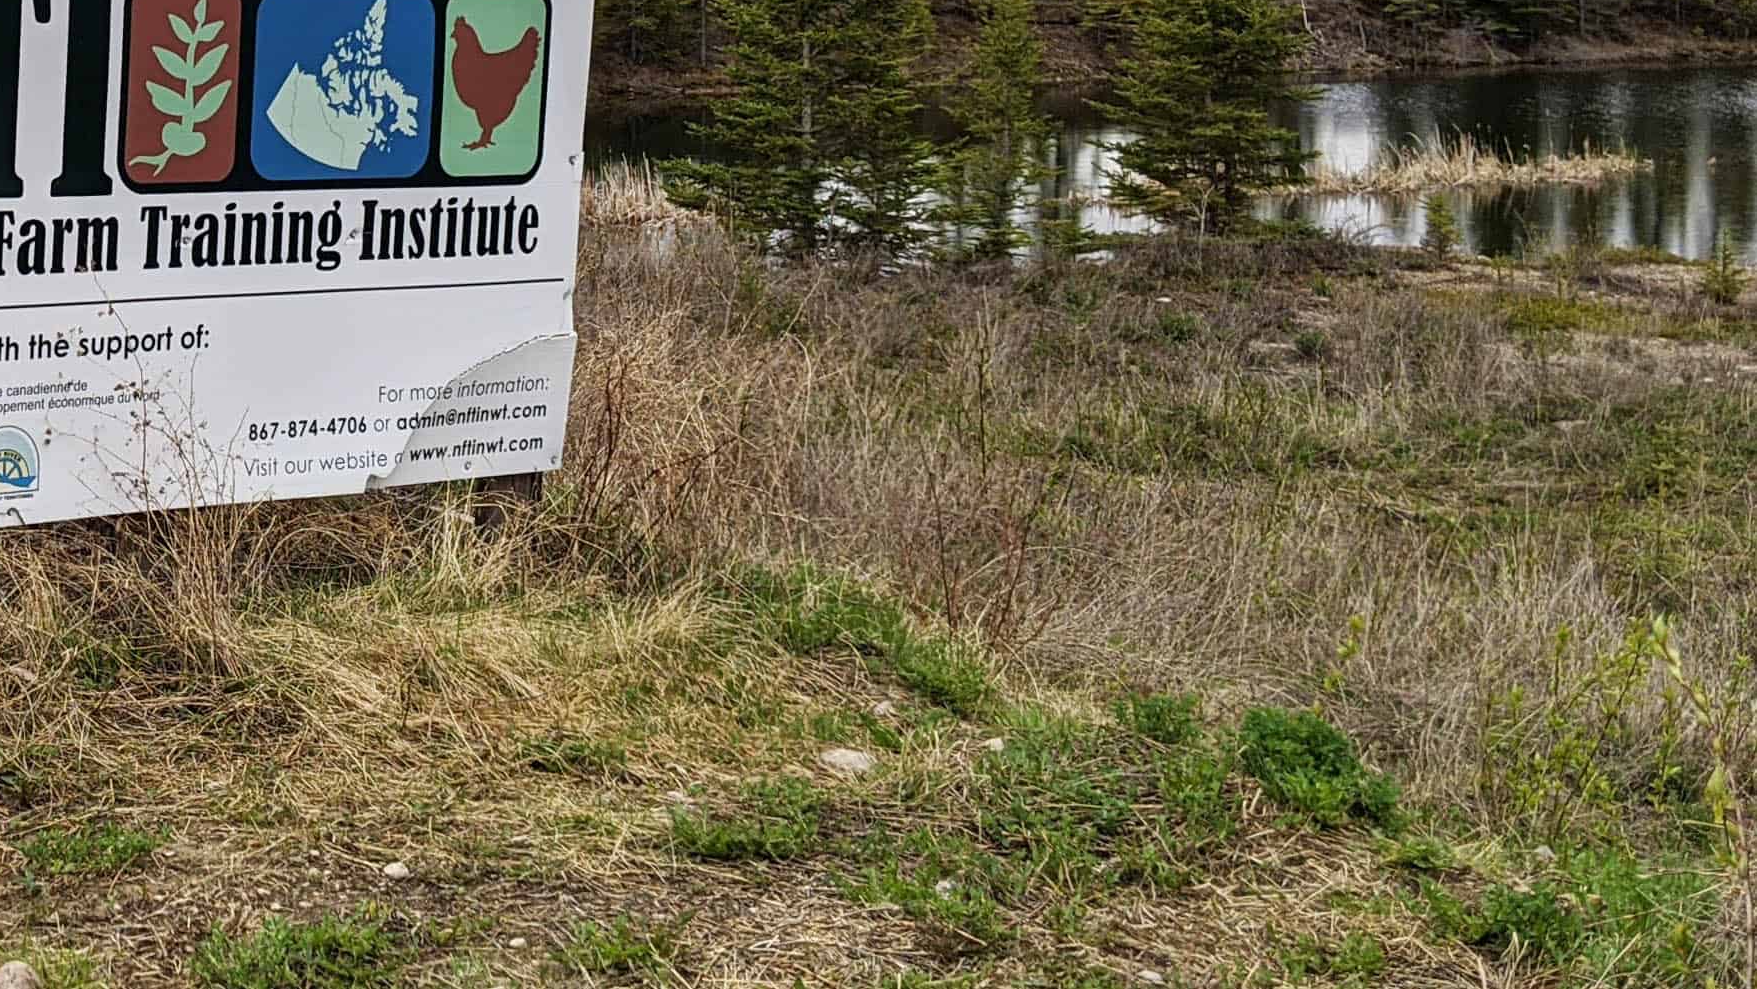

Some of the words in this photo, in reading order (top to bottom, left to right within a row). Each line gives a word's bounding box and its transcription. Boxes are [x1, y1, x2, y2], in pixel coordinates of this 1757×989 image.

[140, 200, 343, 271] Training
[358, 195, 539, 261] Institute
[29, 333, 69, 359] the
[79, 326, 173, 361] support
[180, 324, 210, 350] of:
[6, 382, 70, 399] canadienne
[73, 380, 88, 393] de
[48, 393, 115, 410] économique
[117, 391, 131, 404] du
[379, 386, 404, 404] For
[410, 387, 453, 401] more
[457, 375, 550, 398] information:
[249, 416, 367, 442] 867-874-4706
[374, 418, 392, 433] or
[396, 402, 548, 431] admin@nftinwt.com
[244, 459, 278, 477] Visit
[285, 459, 314, 475] our
[320, 450, 388, 471] website
[409, 435, 544, 462] www.nftinwt.com
